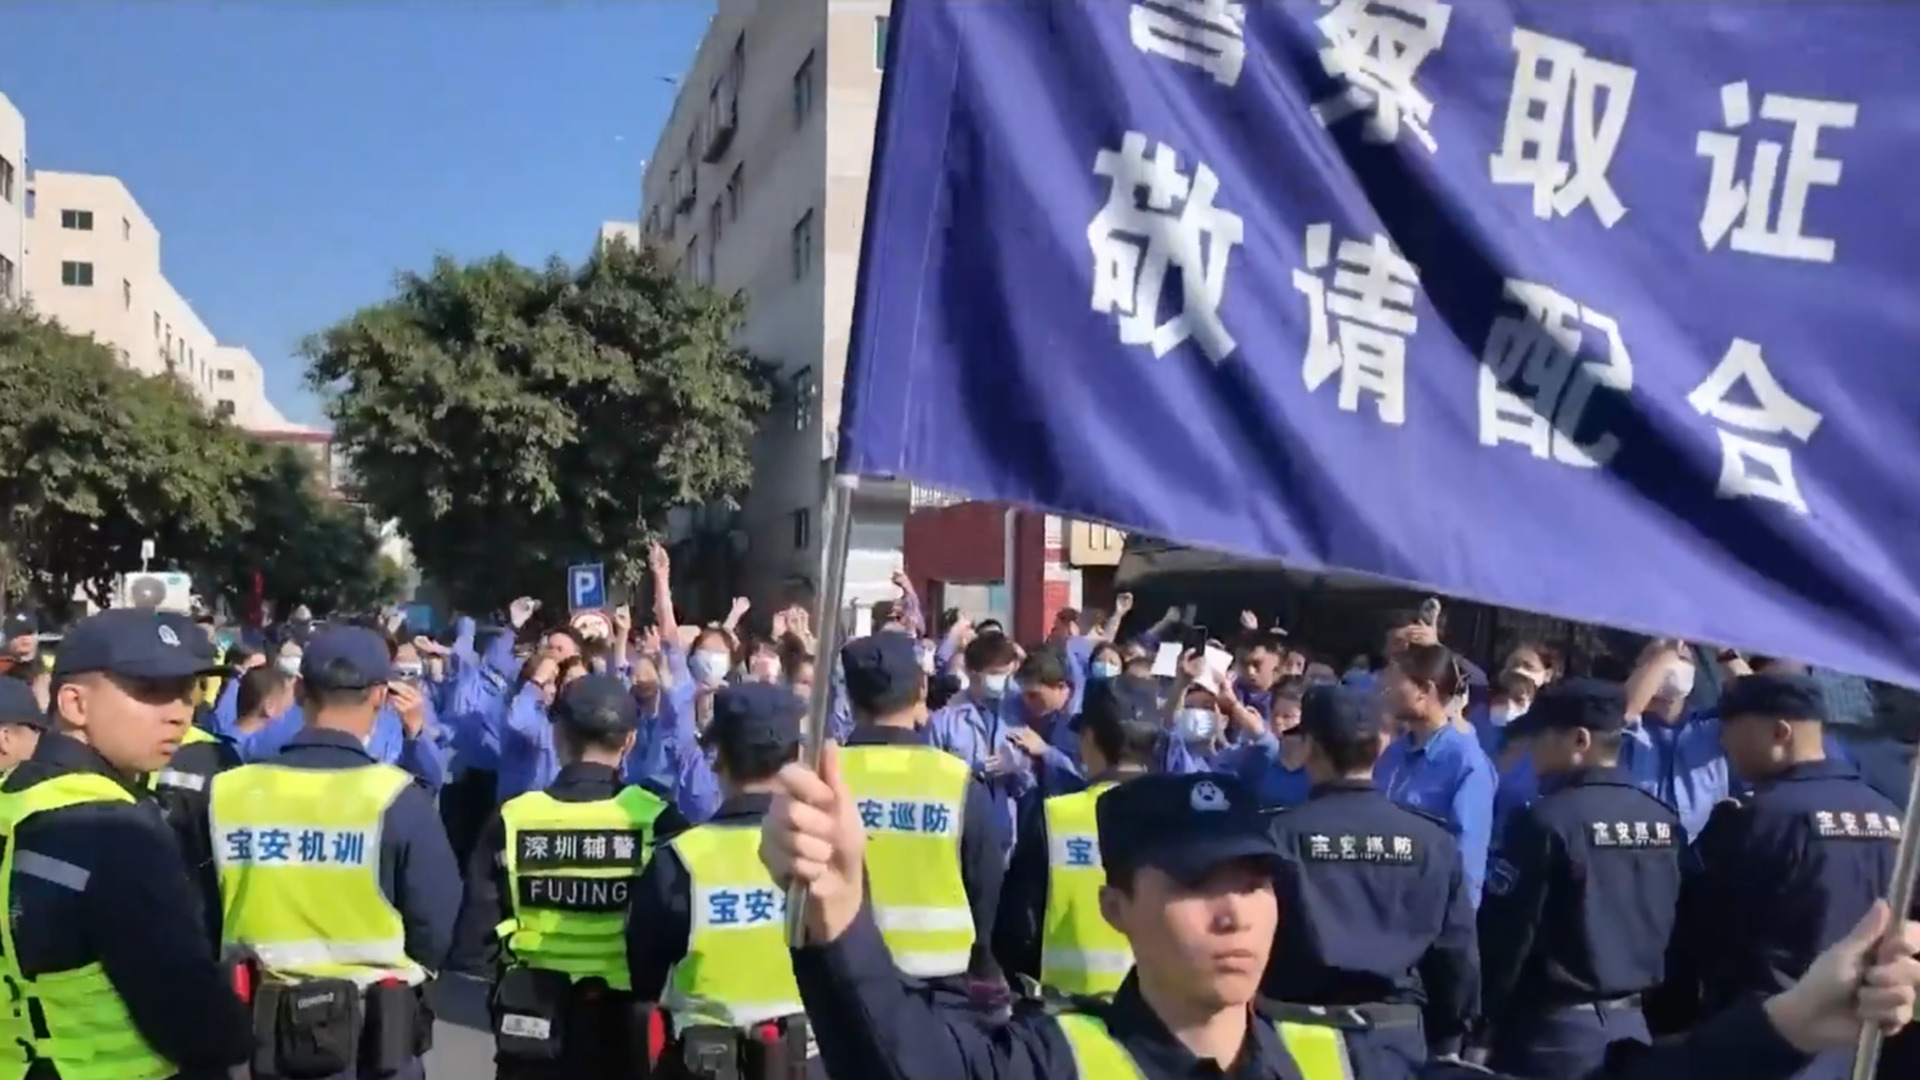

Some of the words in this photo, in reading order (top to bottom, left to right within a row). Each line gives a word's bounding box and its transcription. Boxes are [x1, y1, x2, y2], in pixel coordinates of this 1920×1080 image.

[1087, 130, 1824, 515] 敬请配合
[575, 571, 596, 606] P
[227, 829, 363, 864] 宝安机训
[524, 835, 635, 860] 深圳辅警
[531, 878, 628, 905] FUJING
[708, 889, 787, 924] 宝安
